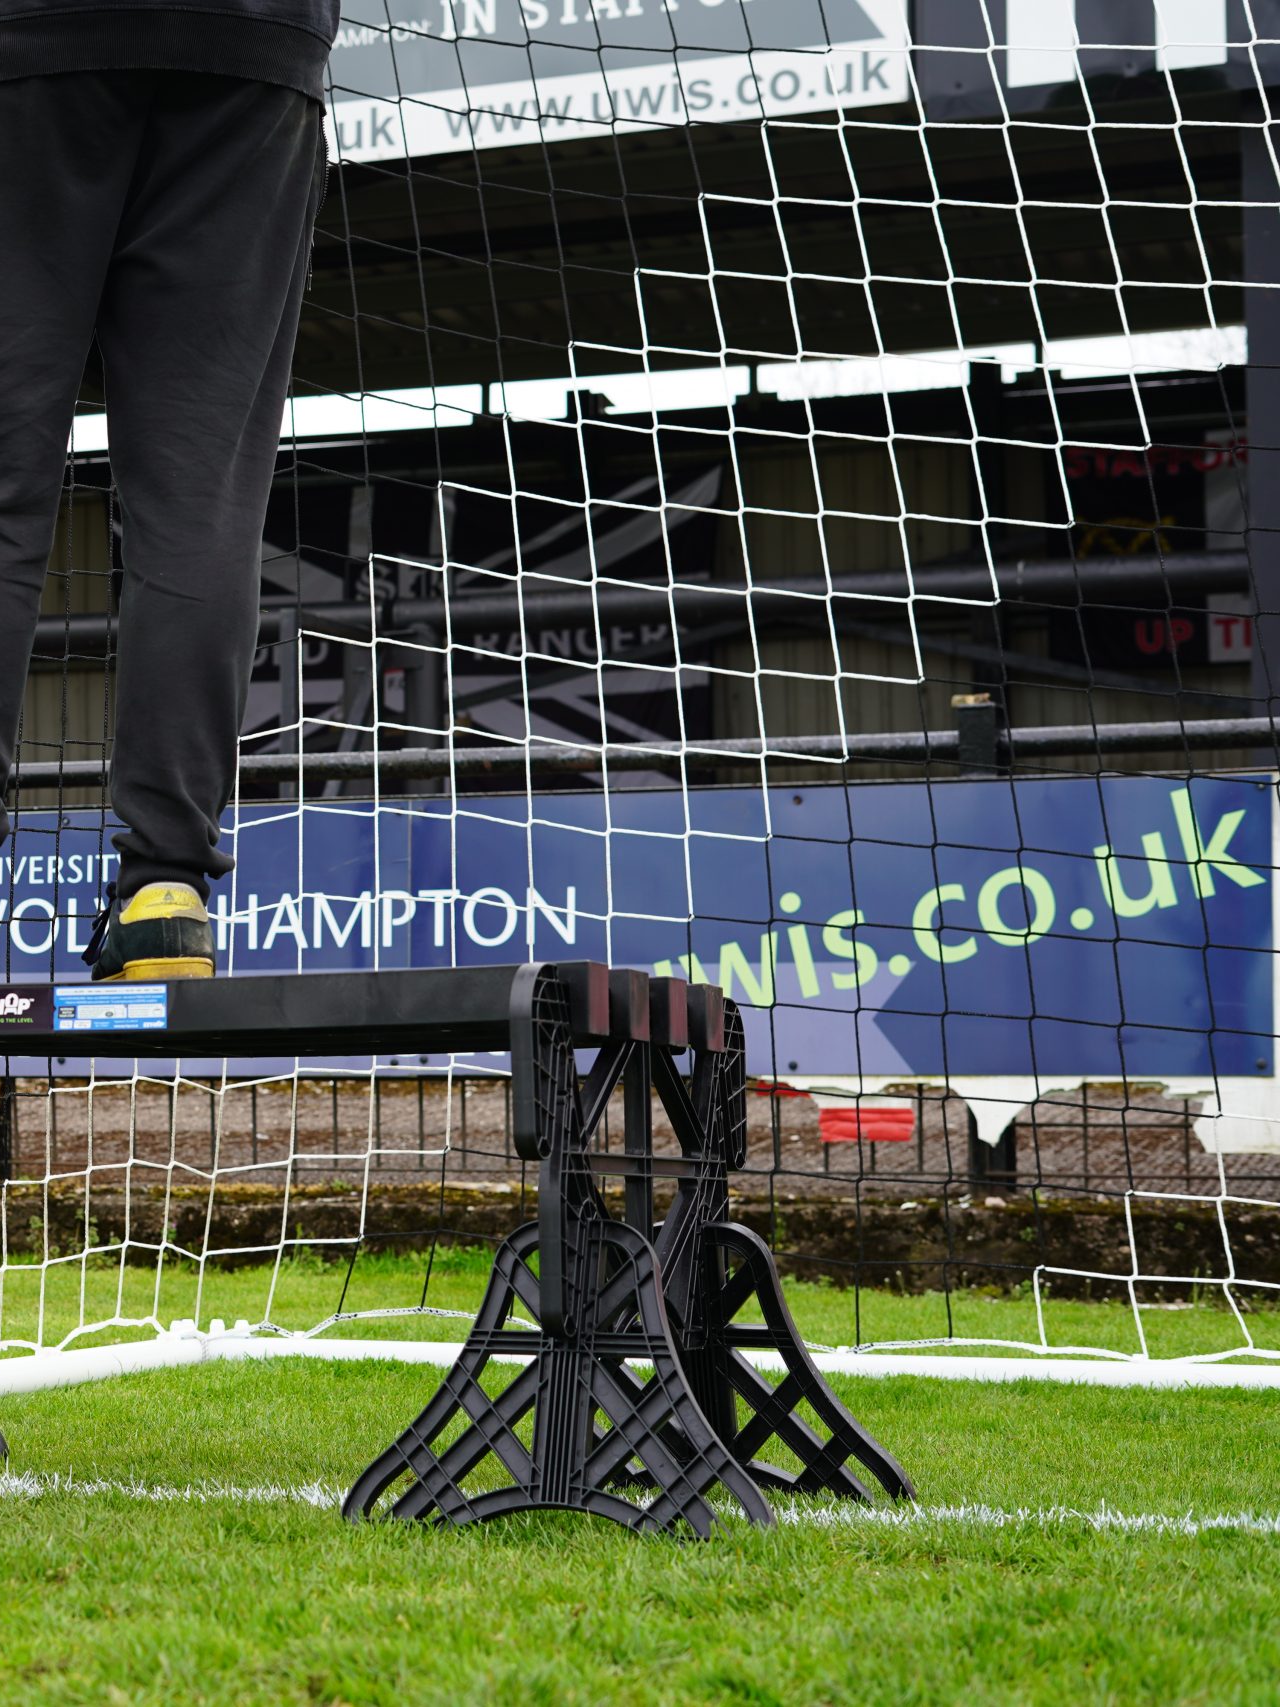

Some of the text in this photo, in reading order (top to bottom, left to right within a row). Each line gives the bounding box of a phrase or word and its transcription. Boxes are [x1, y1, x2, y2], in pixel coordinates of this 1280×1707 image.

[332, 19, 429, 49] AMPTON
[337, 51, 891, 151] uk www.uwis.co.uk
[1134, 616, 1194, 655] UP
[653, 788, 1267, 1009] wis.co.uk
